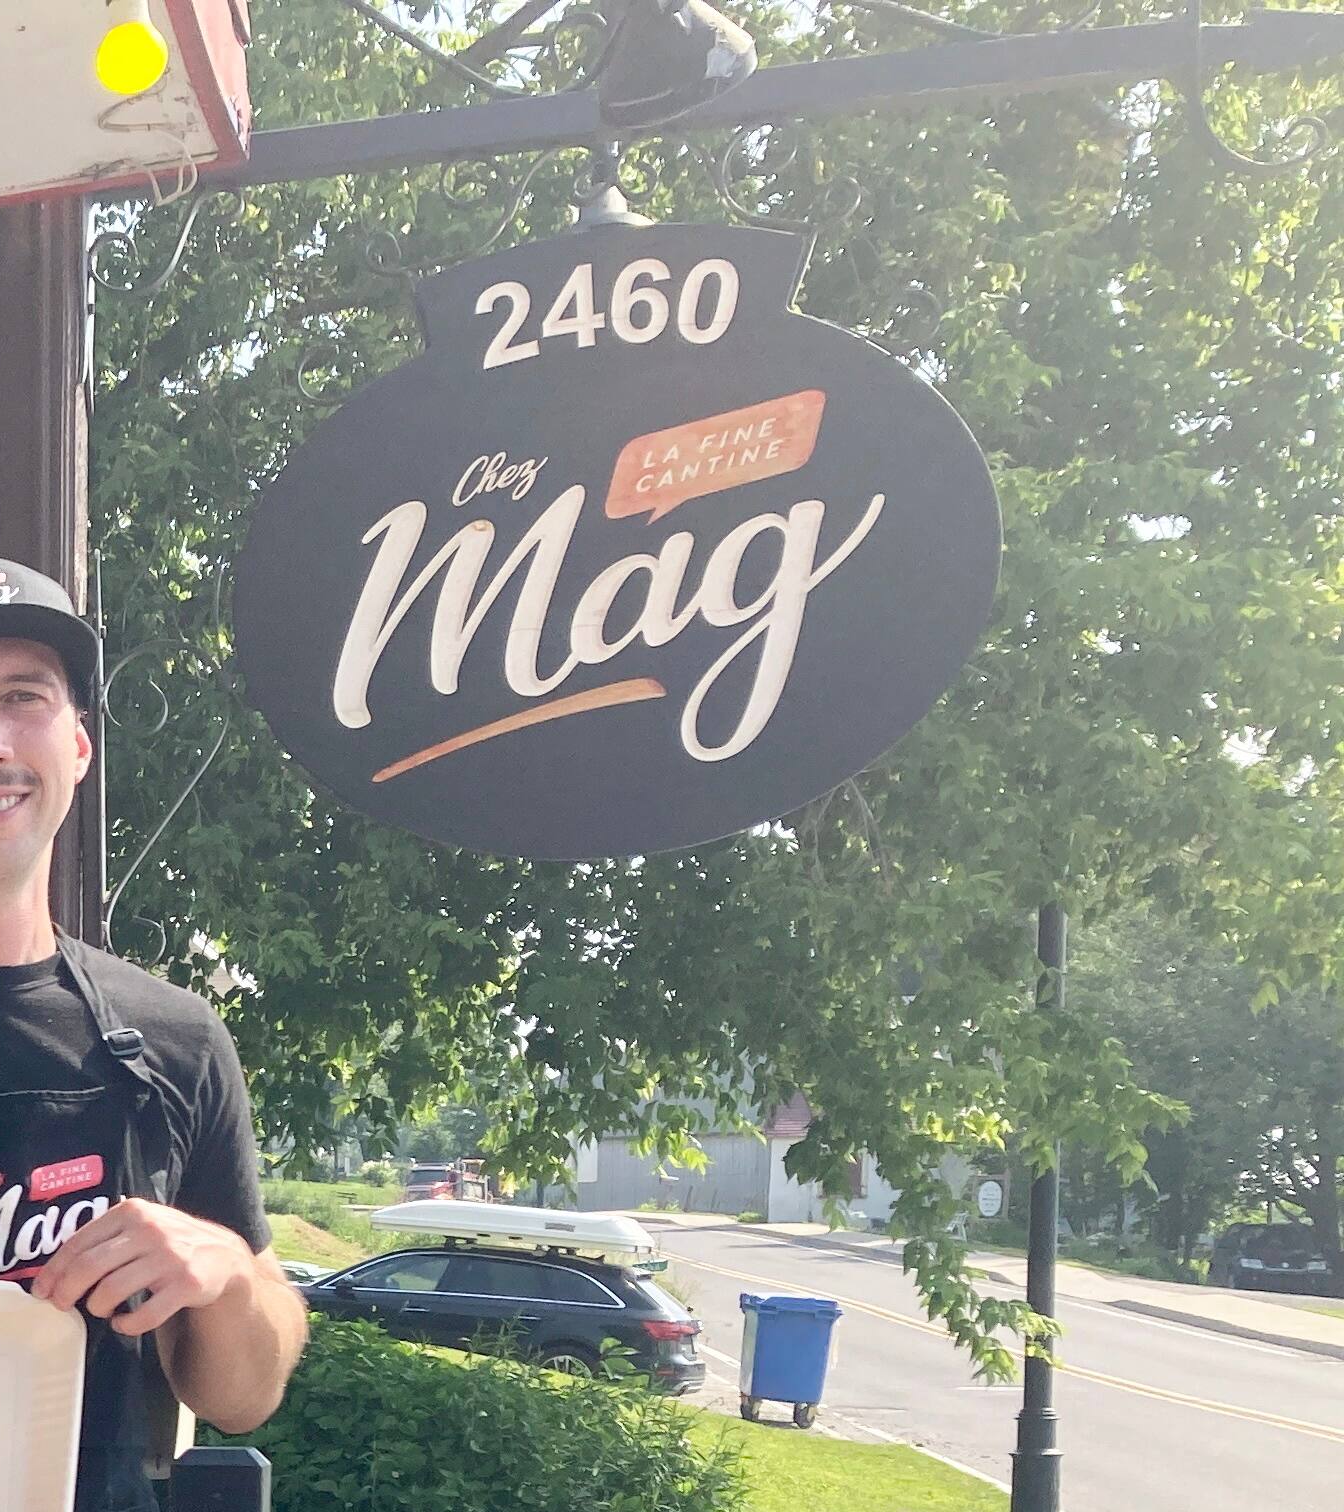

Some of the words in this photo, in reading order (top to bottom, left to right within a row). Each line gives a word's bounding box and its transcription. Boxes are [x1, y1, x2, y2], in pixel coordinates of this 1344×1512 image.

[474, 257, 740, 370] 2460
[636, 439, 785, 493] CANTINE
[642, 444, 680, 470] LA
[697, 417, 777, 454] FINE
[452, 450, 549, 507] Chez
[332, 484, 886, 763] Mag
[39, 1172, 93, 1192] CANTINE
